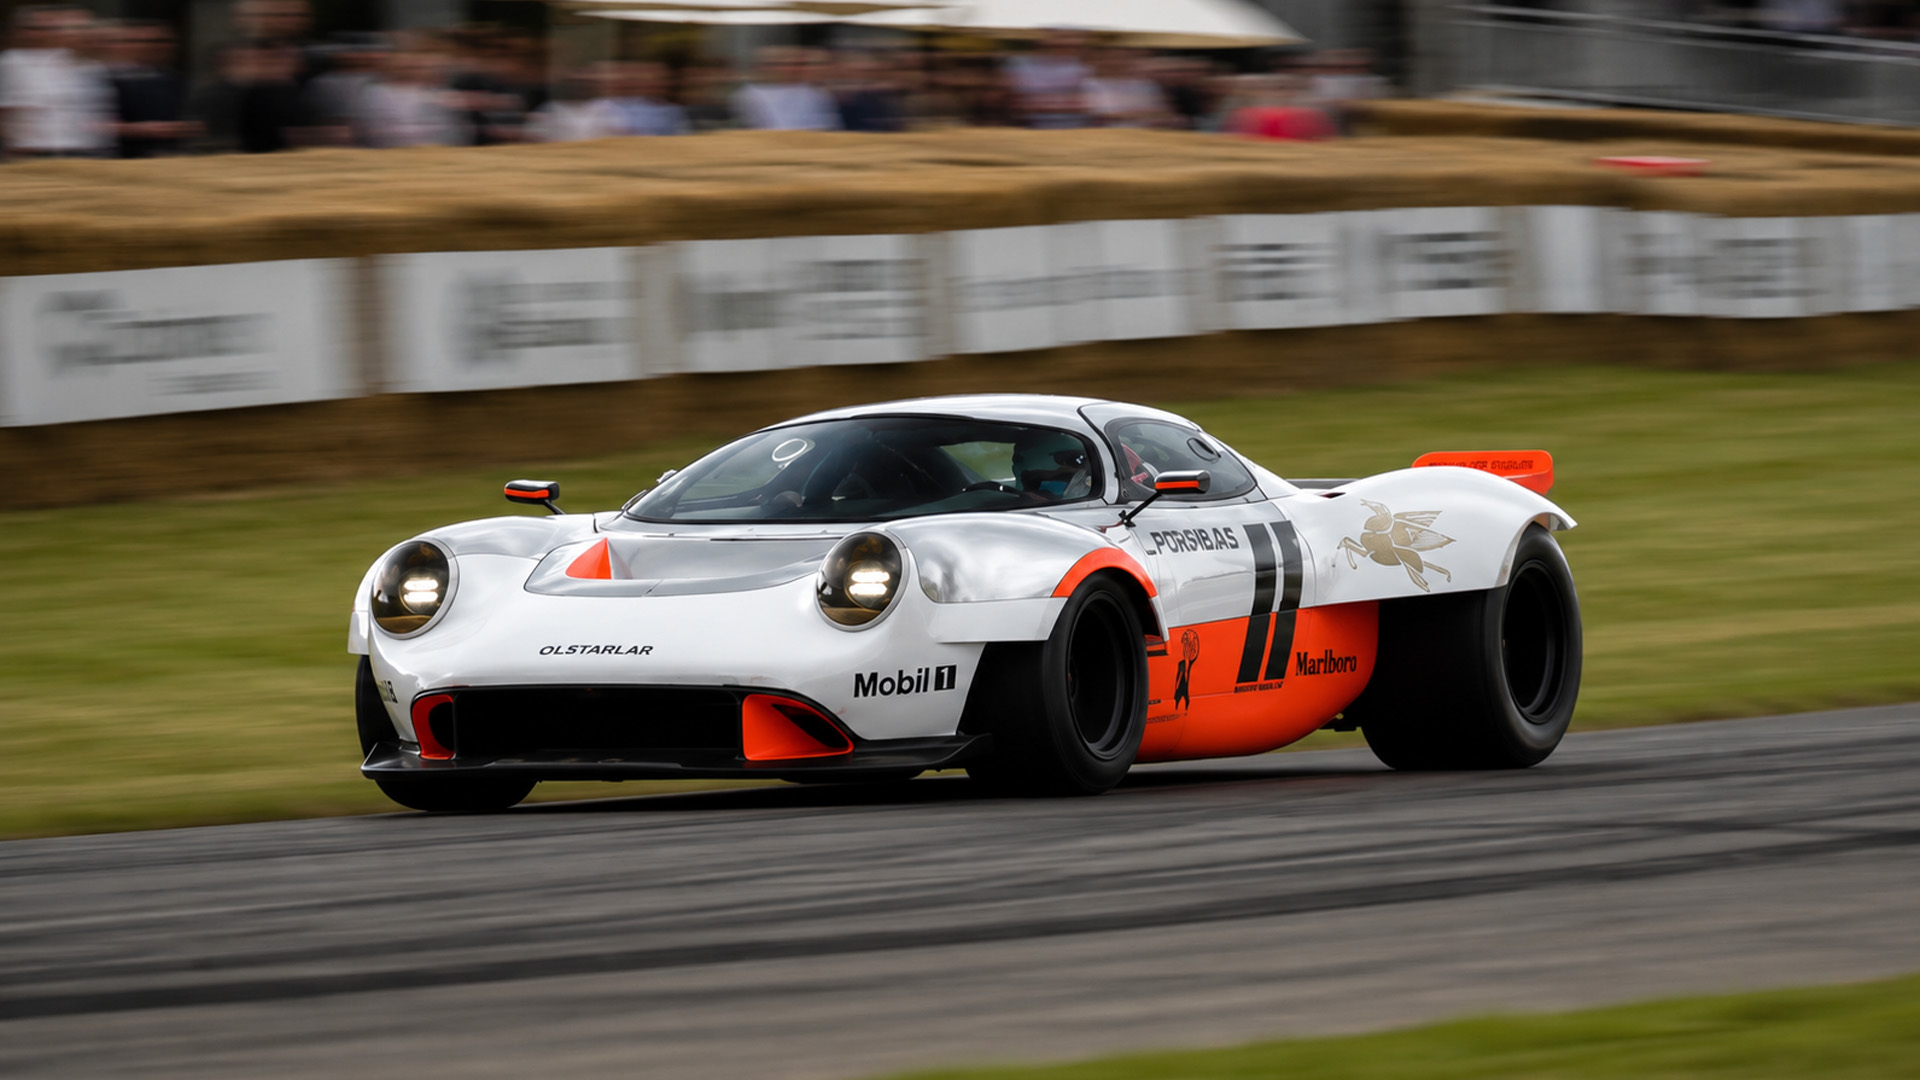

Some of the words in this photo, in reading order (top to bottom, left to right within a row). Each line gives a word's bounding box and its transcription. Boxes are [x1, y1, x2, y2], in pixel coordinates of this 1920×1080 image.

[539, 645, 653, 655] OLSTARLAR
[1295, 649, 1357, 676] Marlboro
[854, 667, 930, 698] Mobil
